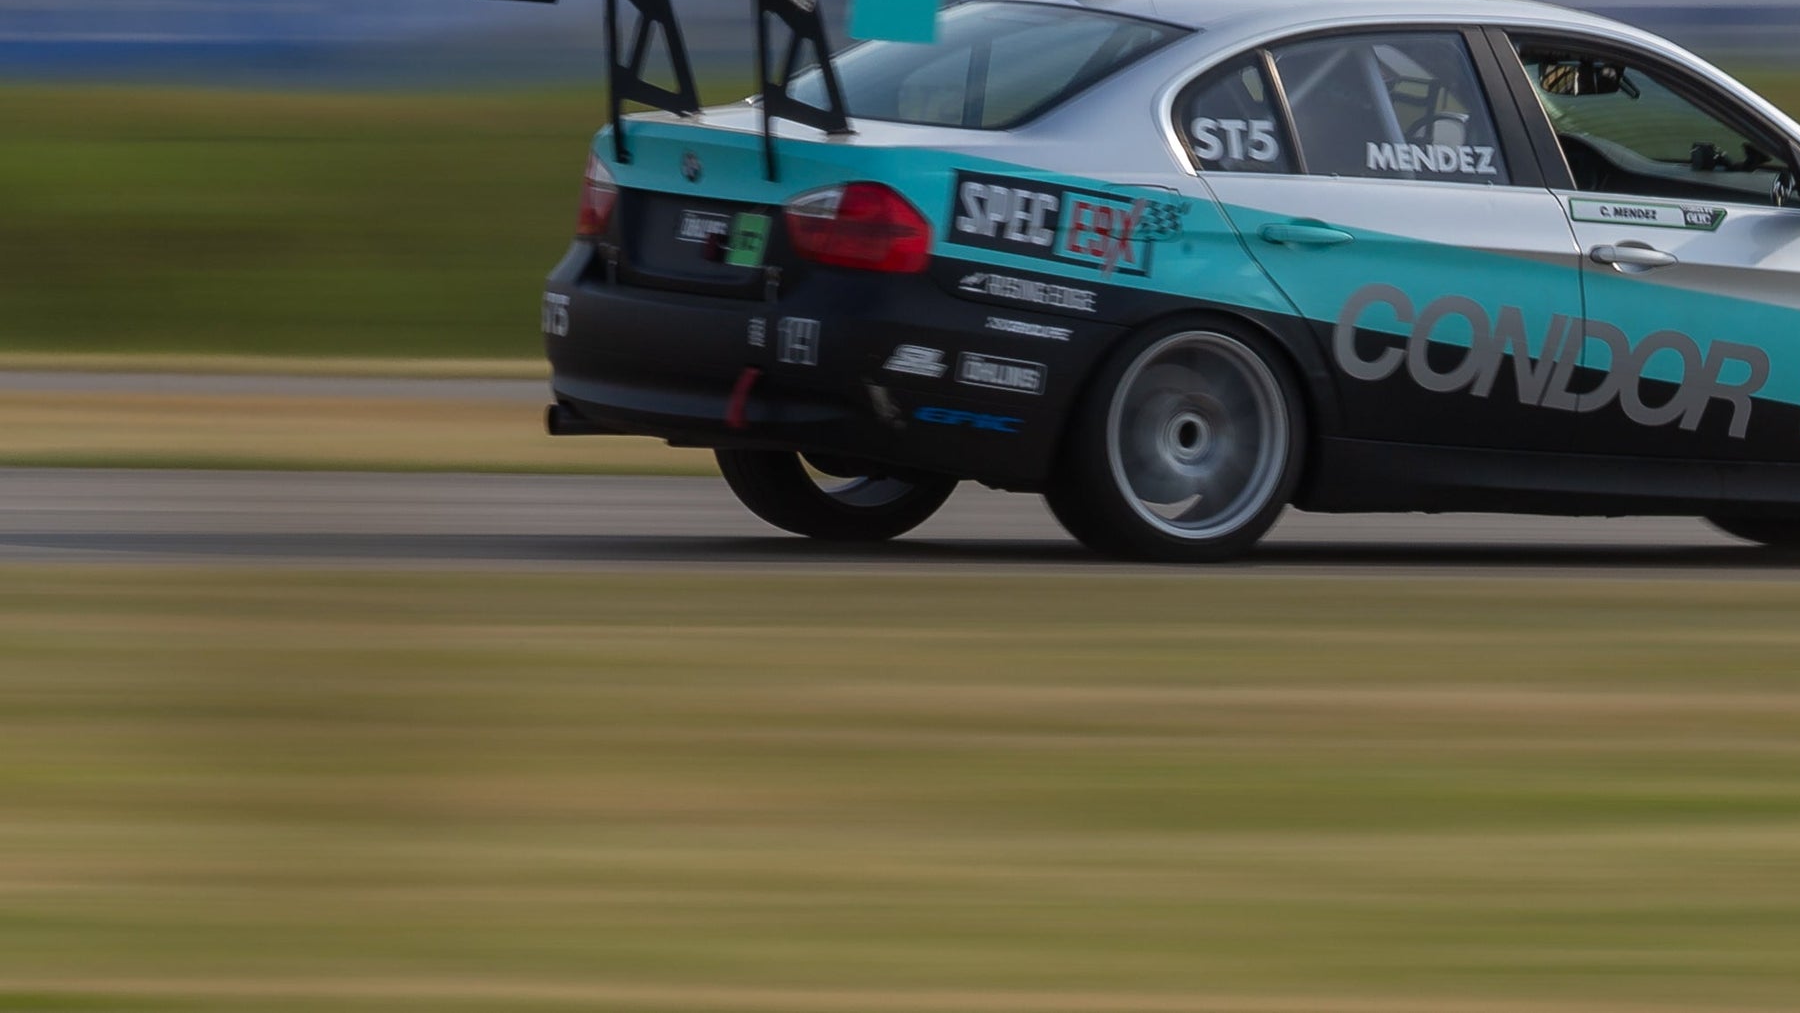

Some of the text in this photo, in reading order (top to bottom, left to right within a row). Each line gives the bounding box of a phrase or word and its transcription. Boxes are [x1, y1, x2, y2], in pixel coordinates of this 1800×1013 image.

[1190, 117, 1281, 164] ST5
[1366, 140, 1498, 176] MENDEZ
[955, 180, 1061, 247] SPEC
[1600, 206, 1659, 221] C. MENDEZ
[1332, 283, 1771, 439] CONDOR
